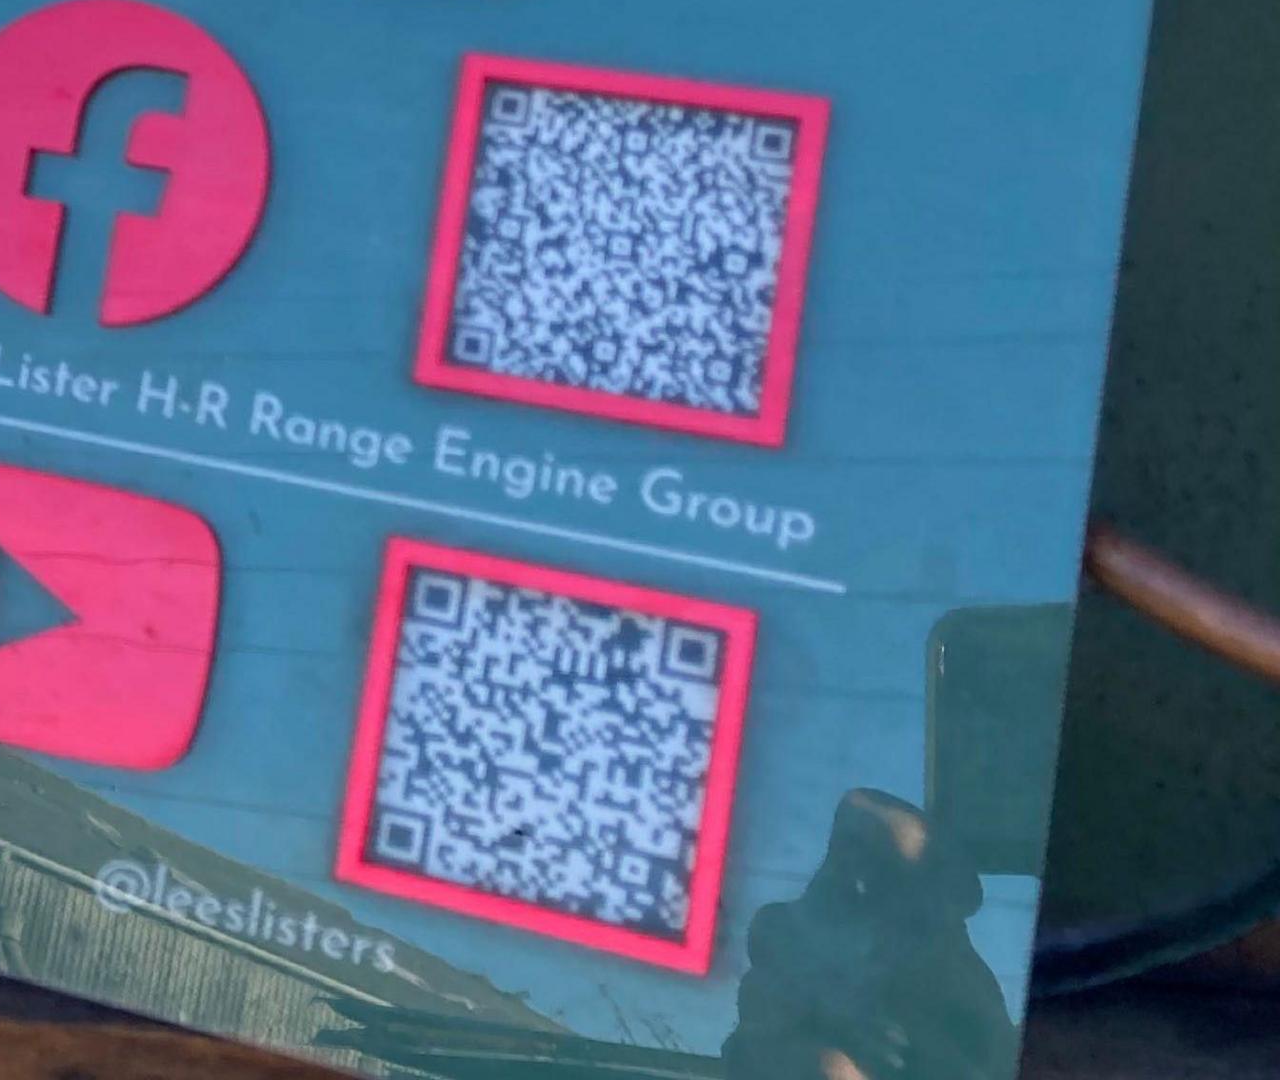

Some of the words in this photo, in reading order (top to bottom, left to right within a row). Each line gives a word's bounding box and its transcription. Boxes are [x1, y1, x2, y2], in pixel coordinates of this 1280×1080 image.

[249, 389, 414, 469] Range
[433, 423, 619, 501] Engine
[641, 467, 816, 552] Group
[96, 858, 397, 973] @leeslisters
